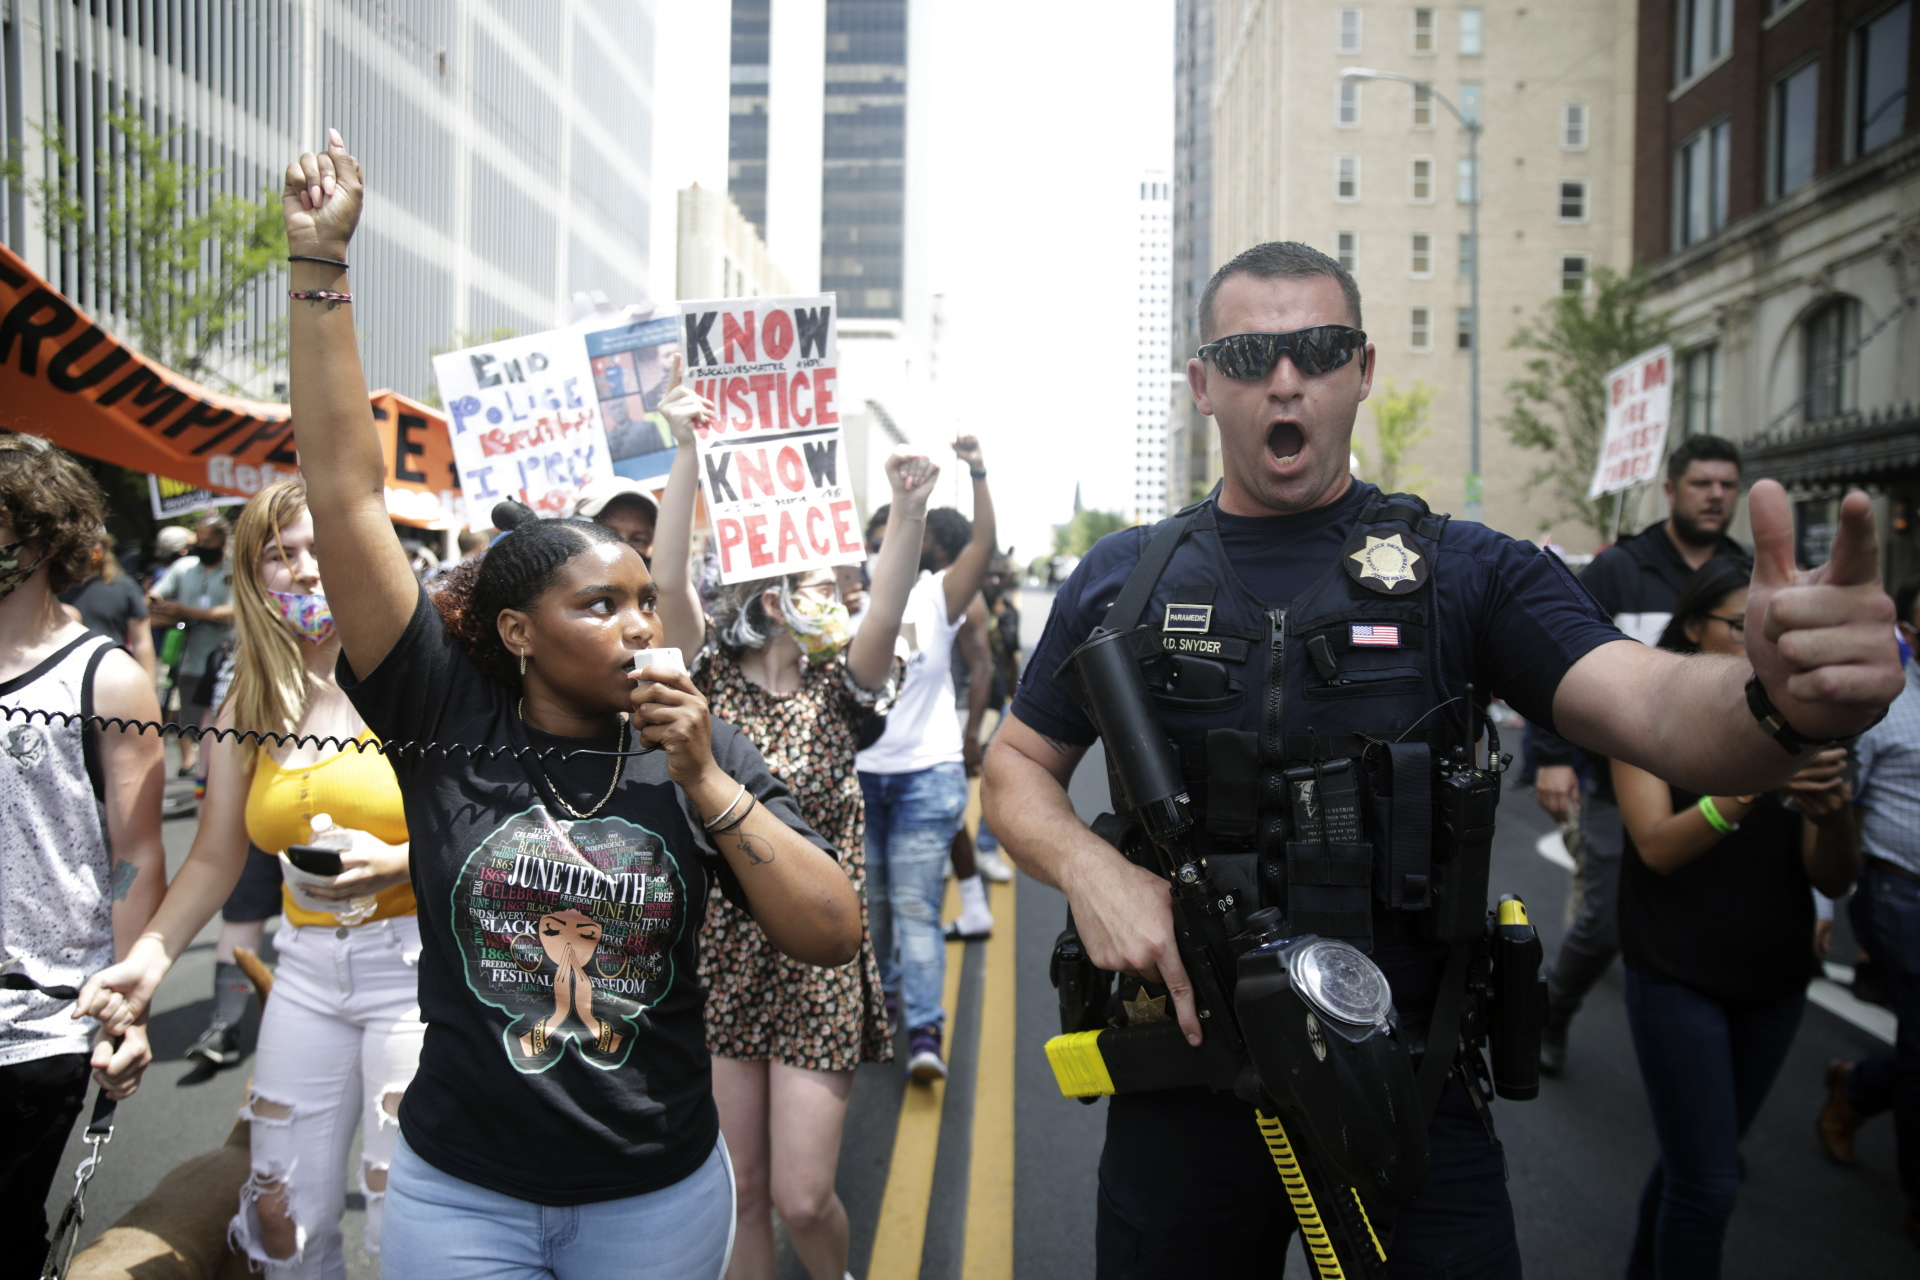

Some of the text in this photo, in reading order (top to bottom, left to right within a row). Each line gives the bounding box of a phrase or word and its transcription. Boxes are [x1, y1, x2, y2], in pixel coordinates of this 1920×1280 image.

[685, 306, 830, 367] KNOW
[470, 352, 548, 390] END
[688, 362, 786, 378] #BLACKLIVESMATTER
[693, 367, 839, 440] JUSTICE
[705, 439, 837, 504] KNOW
[716, 500, 861, 574] PEACE
[1169, 614, 1206, 622] PARAMEDIC
[1179, 638, 1221, 654] SNYDER
[514, 831, 551, 842] CELEBRATE
[517, 841, 549, 858] BLACK
[584, 840, 626, 852] INDEPENDENCE
[491, 857, 515, 871] 1865
[617, 857, 641, 866] FREE
[480, 867, 508, 883] 1865
[624, 865, 648, 874] JUNE
[651, 866, 661, 874] 19
[507, 853, 647, 905] JUNETEENTH
[472, 880, 484, 896] TEXAS
[483, 882, 559, 906] CELEBRATE
[645, 882, 654, 902] TEXAS
[469, 896, 501, 910] JUNE 19
[560, 893, 593, 906] FREEDOM
[653, 892, 674, 903] FREE
[502, 900, 526, 911] 1865
[526, 902, 554, 914] BLACK
[589, 900, 644, 923] JUNE 19
[469, 907, 527, 921] END SLAVERY
[480, 919, 539, 934] BLACK
[592, 915, 641, 930] JUNETEENTH
[483, 930, 513, 944] TEXAS
[603, 924, 628, 938] FREE
[485, 938, 505, 950] FREE
[601, 934, 624, 946] TEXAS
[481, 947, 513, 961] 1865
[596, 944, 623, 956] BLACK
[481, 959, 518, 969] FREEDOM
[514, 953, 540, 962] BLACK
[600, 963, 620, 972] TEXAS
[625, 964, 657, 982] 1865
[491, 968, 554, 987] FESTIVAL
[520, 983, 542, 992] JUNE
[589, 976, 647, 994] FREEDOM
